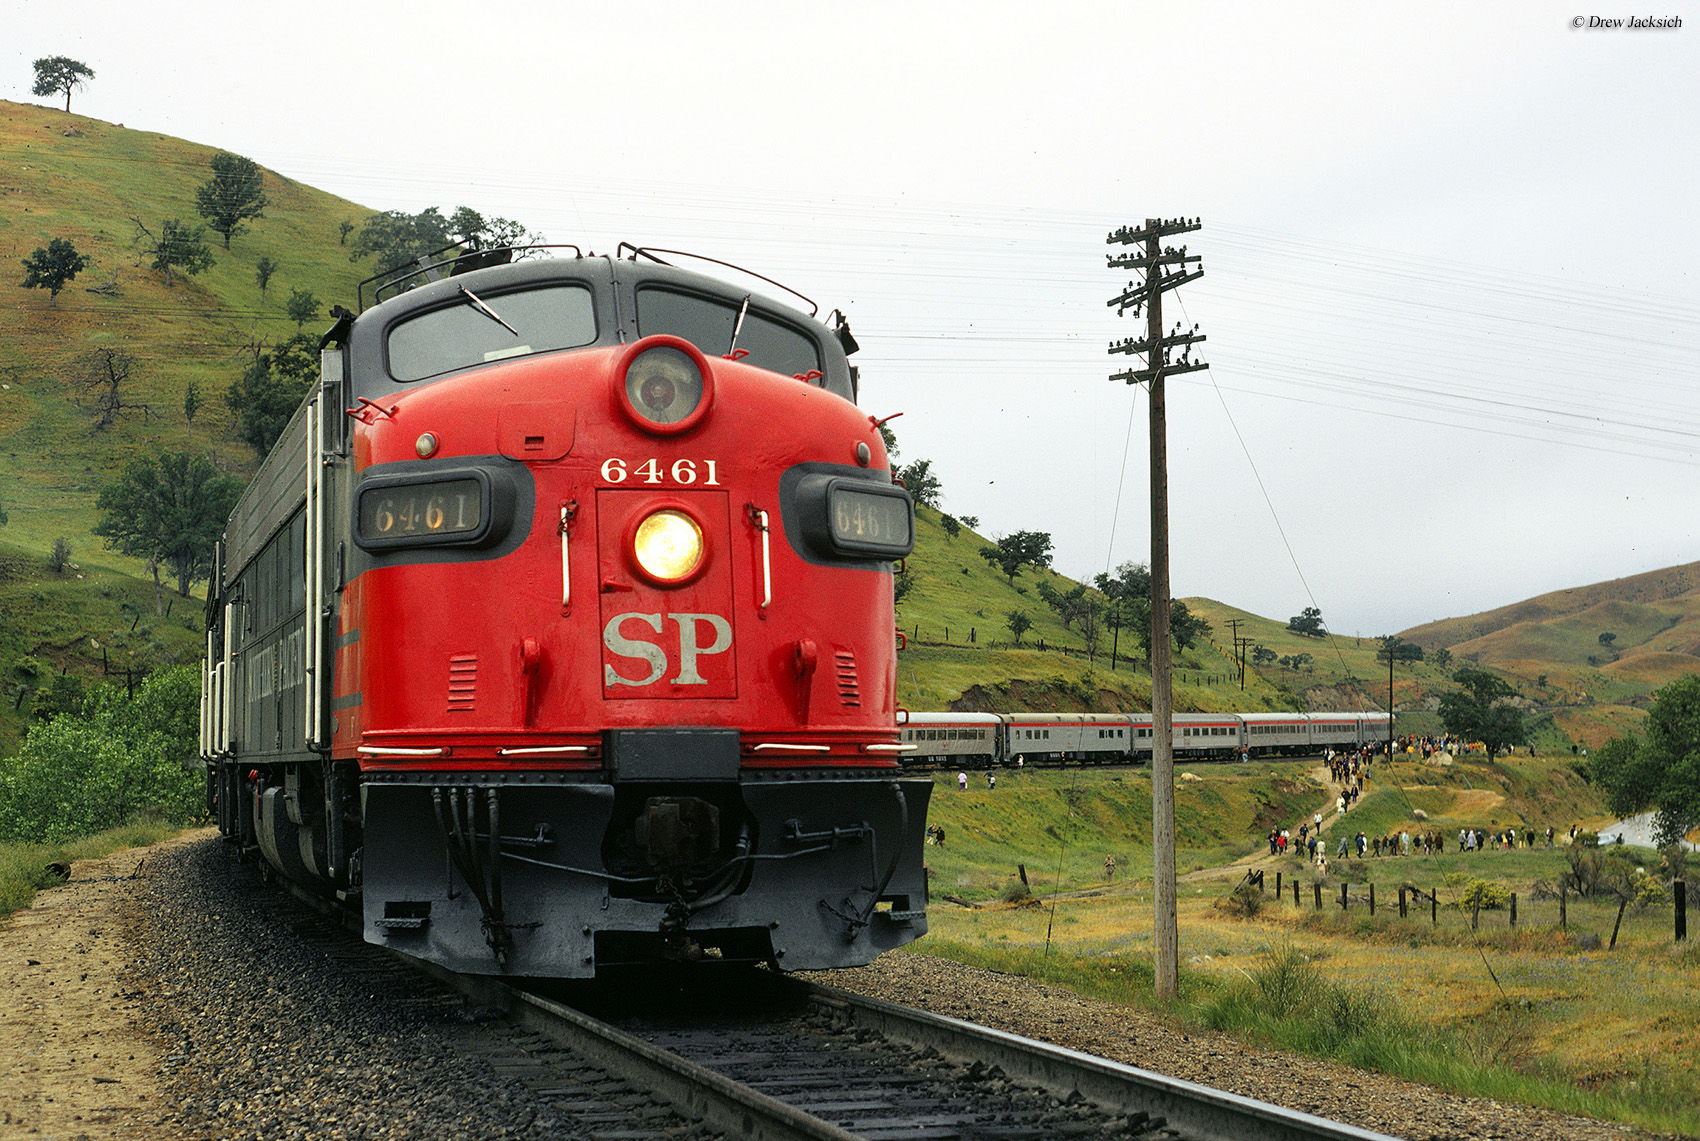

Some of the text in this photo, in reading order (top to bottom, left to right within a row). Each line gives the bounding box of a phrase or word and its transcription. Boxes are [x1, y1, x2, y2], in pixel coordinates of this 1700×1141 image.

[600, 457, 721, 486] 6461
[375, 494, 467, 532] 6461
[836, 501, 892, 541] 6461
[603, 612, 732, 687] SP
